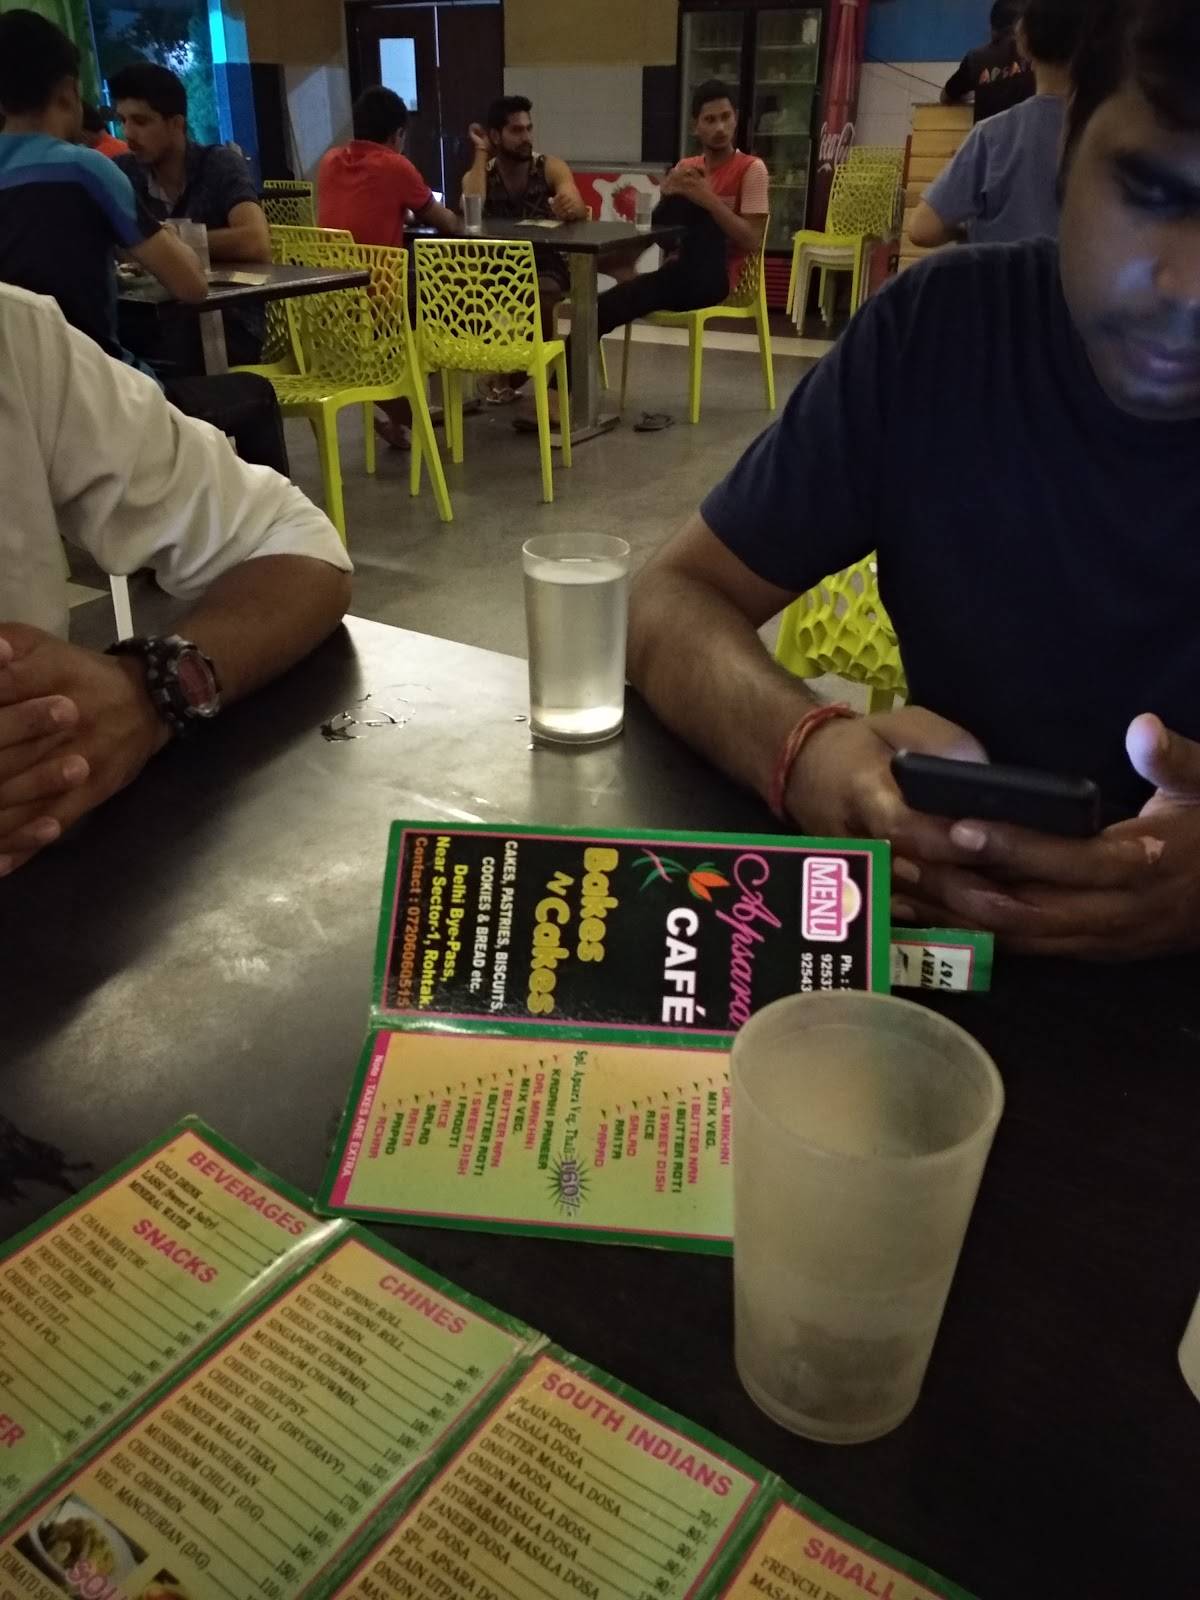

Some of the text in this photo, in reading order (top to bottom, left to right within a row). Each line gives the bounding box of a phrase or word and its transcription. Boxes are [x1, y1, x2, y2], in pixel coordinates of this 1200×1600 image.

[410, 837, 428, 893] Contact
[418, 836, 450, 1009] Near Sector-1, Rohtak.
[440, 864, 468, 982] Delhi Bye-Pass,
[469, 857, 494, 993] COOKIES & BREAD etc.
[489, 840, 518, 1013] CAKES, PASTRIES, BISCUITS,
[577, 847, 619, 961] Bakes
[810, 862, 837, 935] MENU
[527, 897, 570, 1014] Cakes
[662, 907, 706, 1023] CAFÉ
[714, 853, 781, 1028] Apsara
[840, 954, 852, 975] Ph.
[352, 1118, 366, 1139] ARE
[359, 1085, 375, 1115] TAXES
[437, 1100, 451, 1128] RICE
[449, 1102, 466, 1148] FROOTI
[496, 1089, 513, 1137] BUTTER
[512, 1078, 530, 1134] MIX VEG.
[644, 1110, 656, 1140] RICE
[705, 1091, 717, 1149] MIX VEG.
[457, 1098, 481, 1175] SWEET DISH
[473, 1094, 497, 1176] BUTTER ROTI
[655, 1113, 669, 1192] SWEET DISH
[672, 1108, 686, 1193] BUTTER ROTI
[688, 1103, 700, 1184] BUTTER NAN
[187, 1151, 307, 1235] BEVERAGES
[131, 1219, 218, 1283] SNACKS
[375, 1308, 402, 1329] ROLL
[378, 1275, 467, 1334] CHINES
[376, 1329, 405, 1352] ROLL
[505, 1412, 550, 1445] MASALA
[549, 1440, 584, 1469] DOSA
[514, 1396, 550, 1421] PLAIN
[547, 1417, 582, 1445] DOSA
[541, 1373, 733, 1497] SOUTH INDIANS
[478, 1438, 552, 1493] ONION DOSA
[491, 1423, 623, 1517] BUTTER MASALA DOSA
[428, 1497, 511, 1564] PANEER DOSA
[454, 1466, 579, 1561] PAPER MASALA DOSA
[466, 1453, 592, 1546] ONION MASALA DOSA
[387, 1545, 428, 1580] PLAIN
[415, 1512, 471, 1560] VIP DOSA
[441, 1483, 600, 1600] HYDRABADI MASALA DOSA
[426, 1549, 477, 1592] APSARA
[761, 1557, 821, 1598] FRENCH
